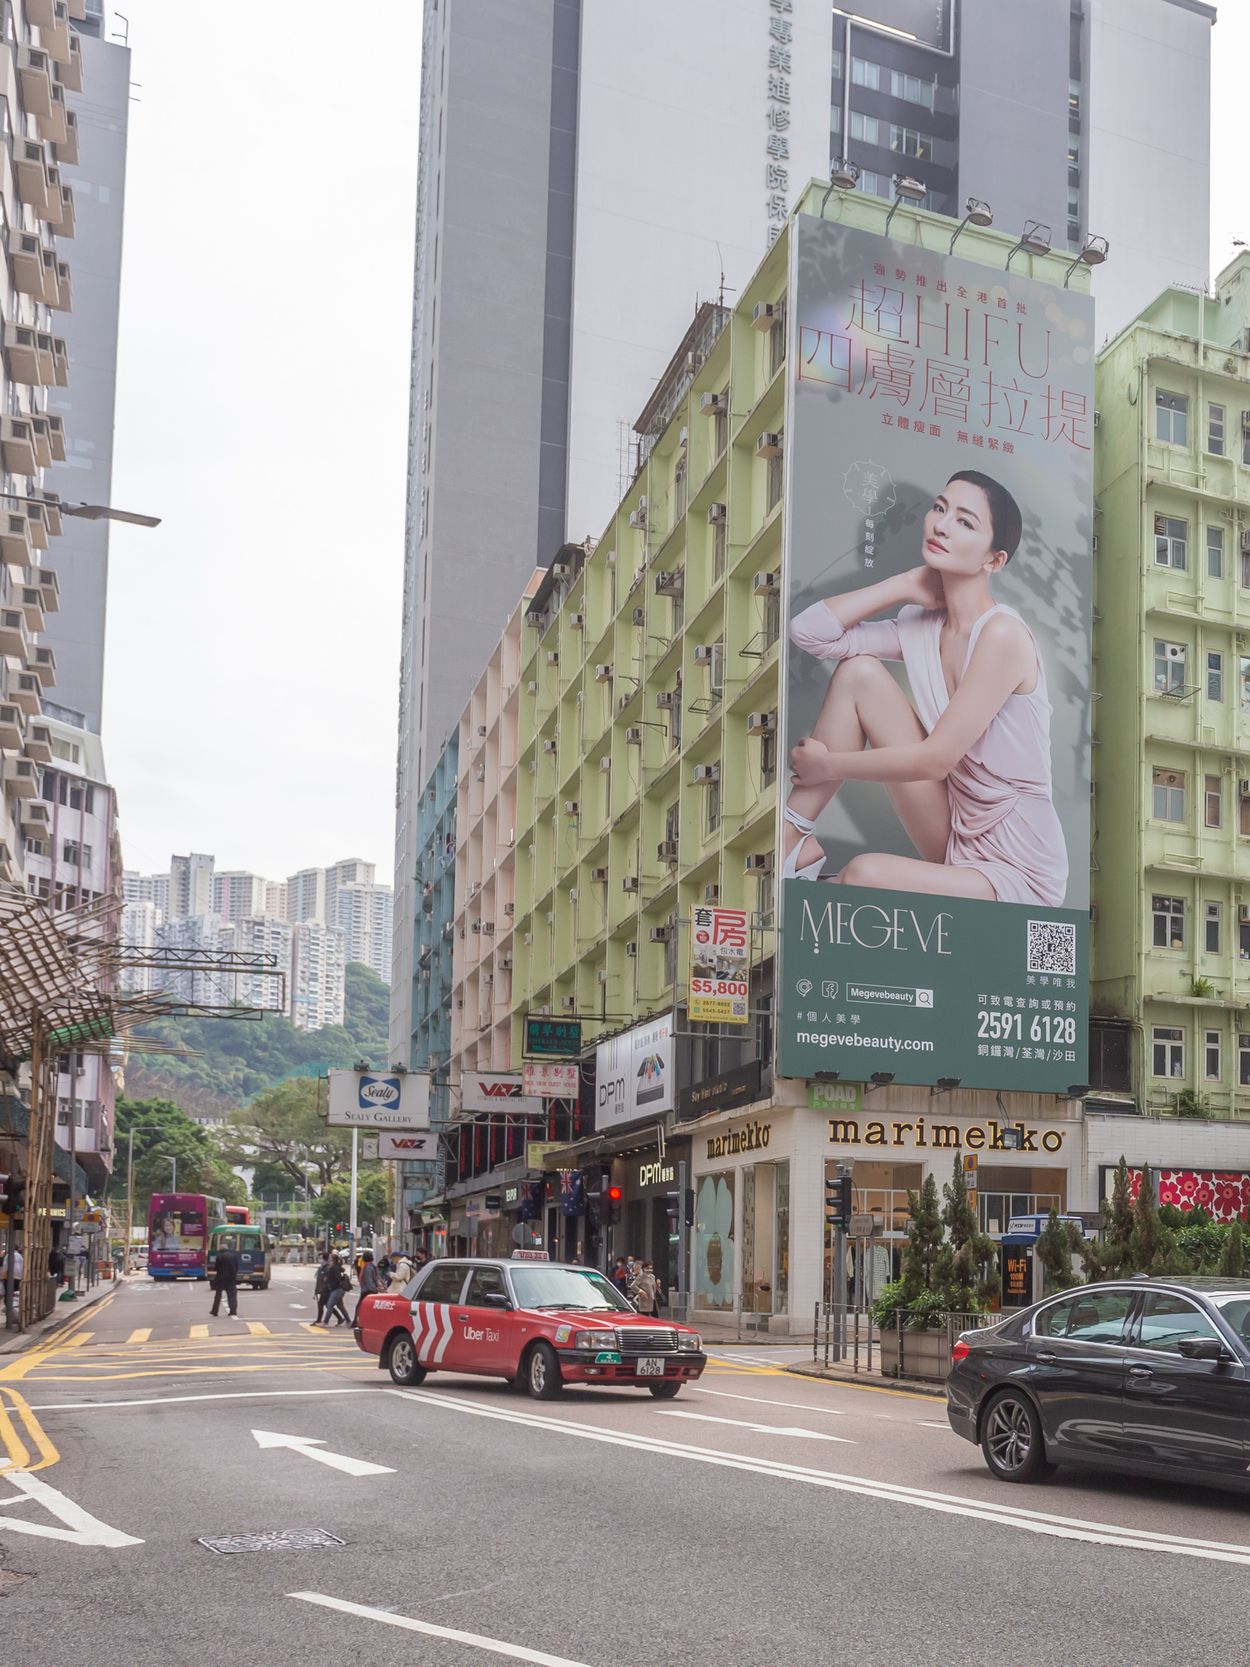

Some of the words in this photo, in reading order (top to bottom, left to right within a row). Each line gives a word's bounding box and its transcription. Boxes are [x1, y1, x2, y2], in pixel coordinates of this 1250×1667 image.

[874, 262, 1027, 315] 強勢推出全港首批
[845, 279, 1051, 379] 超HIFU
[797, 326, 1091, 450] 四膚層拉提
[882, 412, 941, 438] 立體瘦面
[956, 430, 1015, 455] 無縫緊緻
[695, 908, 747, 947] 套房
[800, 899, 954, 955] MEGEVE
[692, 979, 748, 996] $5,800
[1026, 975, 1076, 989] 美學唯我
[851, 988, 914, 1002] Megevebeauty
[978, 994, 1076, 1012] 可致電查詢或預約
[978, 1011, 1022, 1040] 2591
[1030, 1015, 1076, 1044] 6128
[797, 1031, 934, 1052] megevebeauty.com
[364, 1085, 394, 1101] Sealy
[599, 1077, 625, 1107] DPM
[813, 1085, 856, 1102] POAD
[345, 1111, 370, 1121] SEALY
[374, 1113, 413, 1123] GALLERY
[707, 1121, 770, 1159] marimekko
[829, 1118, 1063, 1152] marimekko
[640, 1162, 661, 1187] DPM
[1007, 1257, 1027, 1272] Wi-Fi
[464, 1326, 484, 1340] Uber
[485, 1327, 499, 1342] Taxi
[640, 1366, 661, 1375] 6128
[645, 1358, 657, 1367] AN
